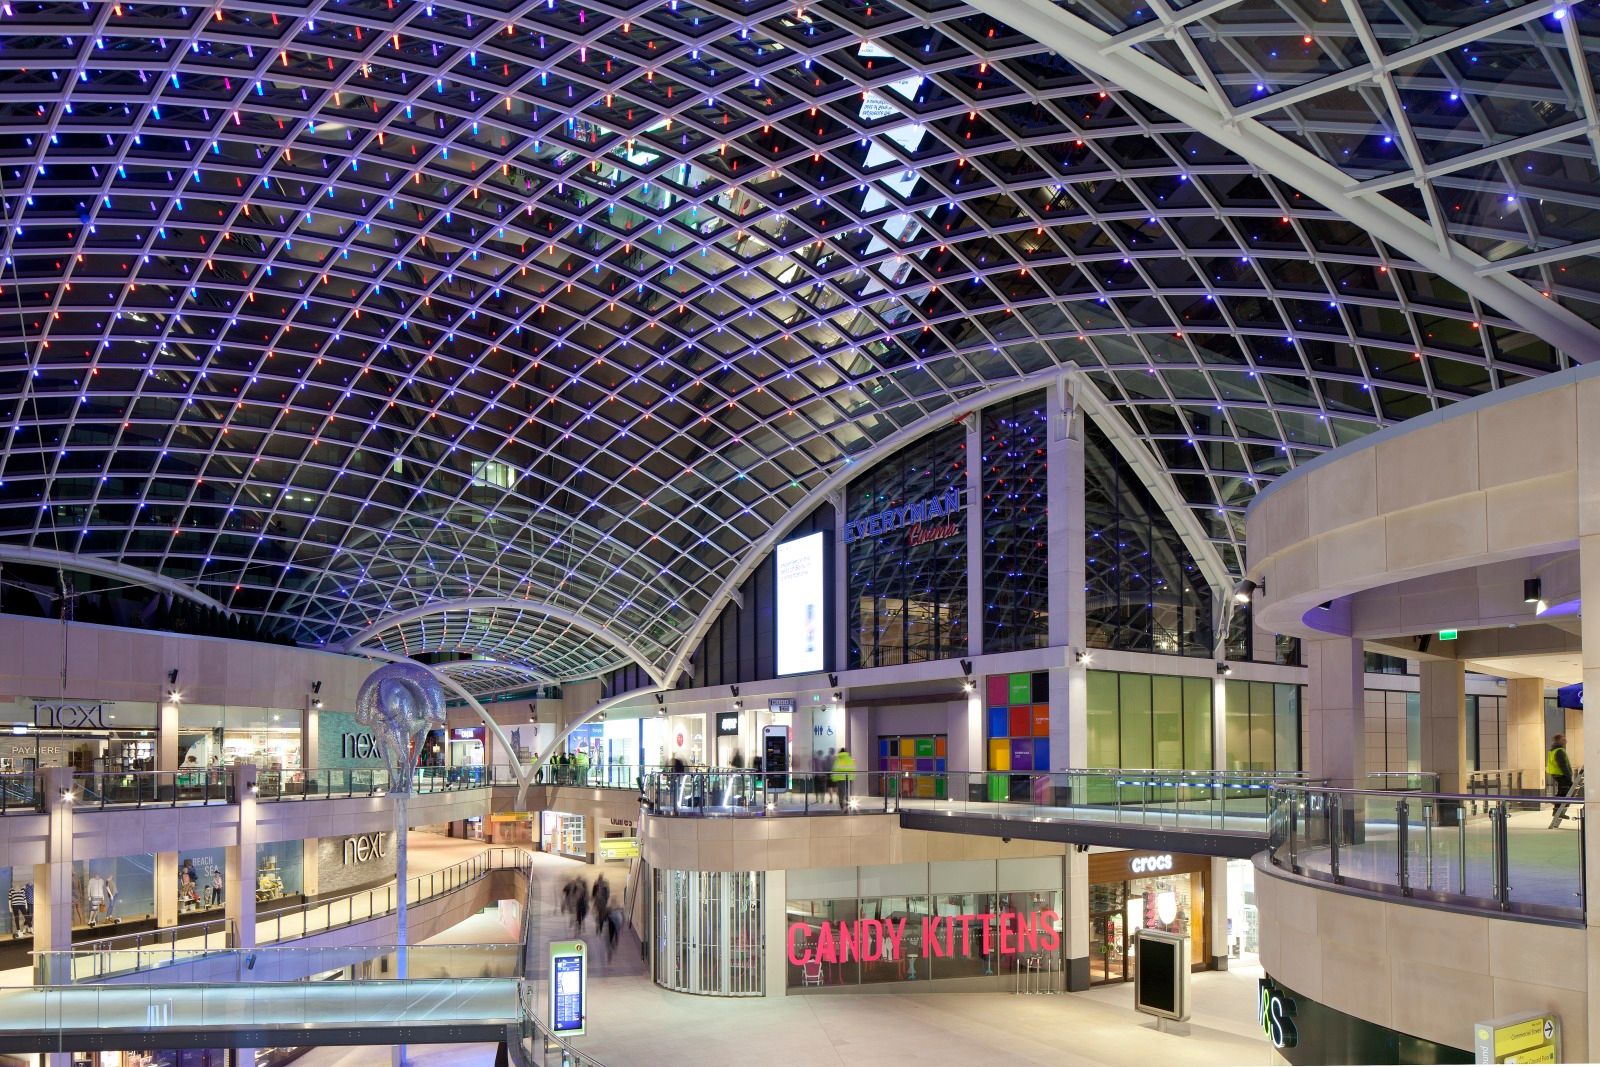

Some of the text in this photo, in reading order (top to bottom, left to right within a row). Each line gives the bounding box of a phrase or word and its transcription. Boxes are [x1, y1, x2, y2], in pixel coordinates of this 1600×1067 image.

[843, 487, 960, 544] EVERYMAN
[908, 522, 959, 547] Cinema
[34, 704, 113, 729] next
[12, 746, 61, 754] PAY HERE
[342, 732, 382, 759] nex
[192, 855, 213, 867] BEACH
[343, 831, 388, 866] next
[1131, 854, 1173, 873] crocs
[788, 910, 1060, 966] CANDY KITTENS
